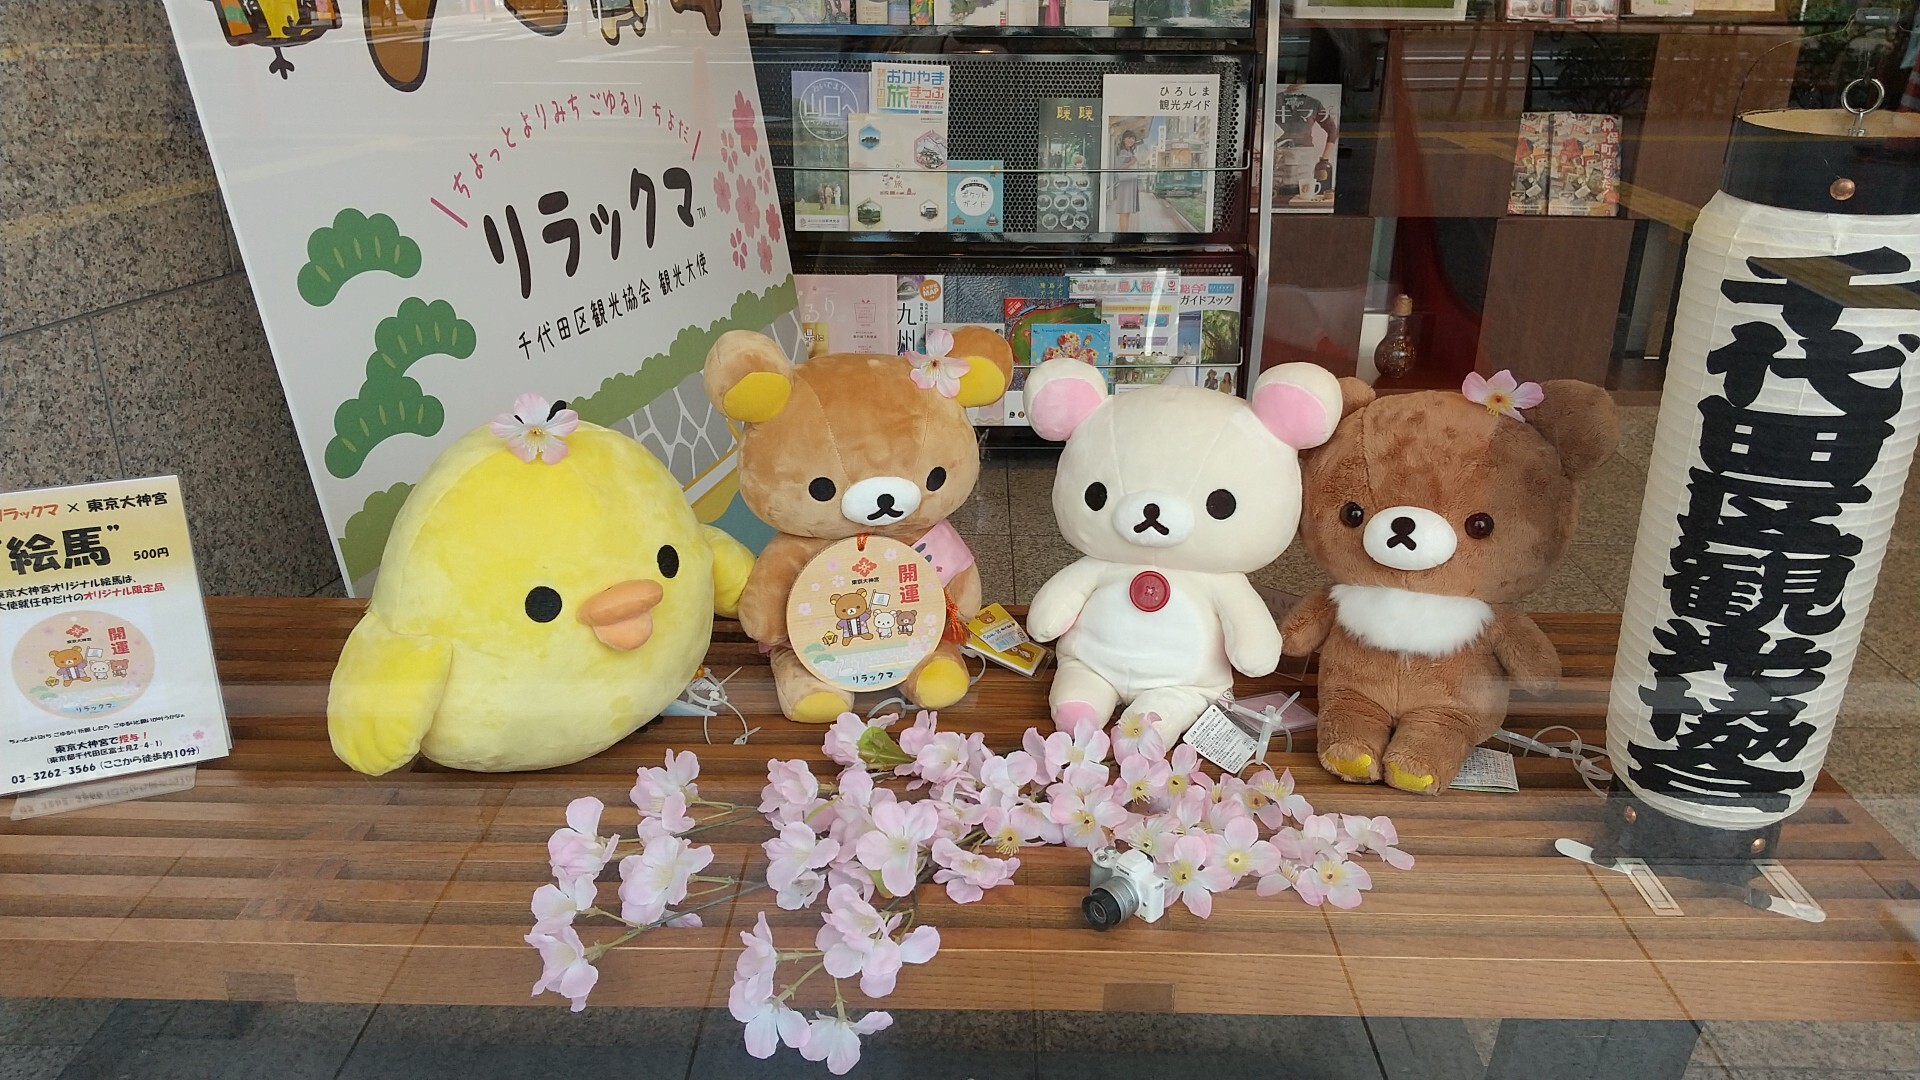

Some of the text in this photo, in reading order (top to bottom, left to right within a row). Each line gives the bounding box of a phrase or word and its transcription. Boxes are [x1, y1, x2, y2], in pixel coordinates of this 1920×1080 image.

[887, 69, 945, 86] おかやま
[887, 84, 909, 108] 旅
[1160, 86, 1210, 97] ひろしま
[589, 90, 643, 118] ごゆるり
[1159, 99, 1211, 111] 観光ガイド
[483, 166, 695, 301] リラックマ
[922, 287, 939, 297] MAP
[1180, 295, 1233, 306] ガイドブック
[518, 251, 710, 361] 千代田区観光協会 観光大使
[897, 302, 917, 352] 九州
[86, 492, 168, 512] 東京大神宮
[1628, 247, 1920, 813] 千代田区観光協会
[133, 547, 169, 561] 500円
[851, 576, 880, 585] 東京大神宮
[898, 563, 920, 604] 開運
[107, 626, 130, 655] 開運
[852, 671, 894, 684] リラックマ
[75, 703, 113, 713] リラックマ
[11, 762, 97, 785] 03-3262-3566
